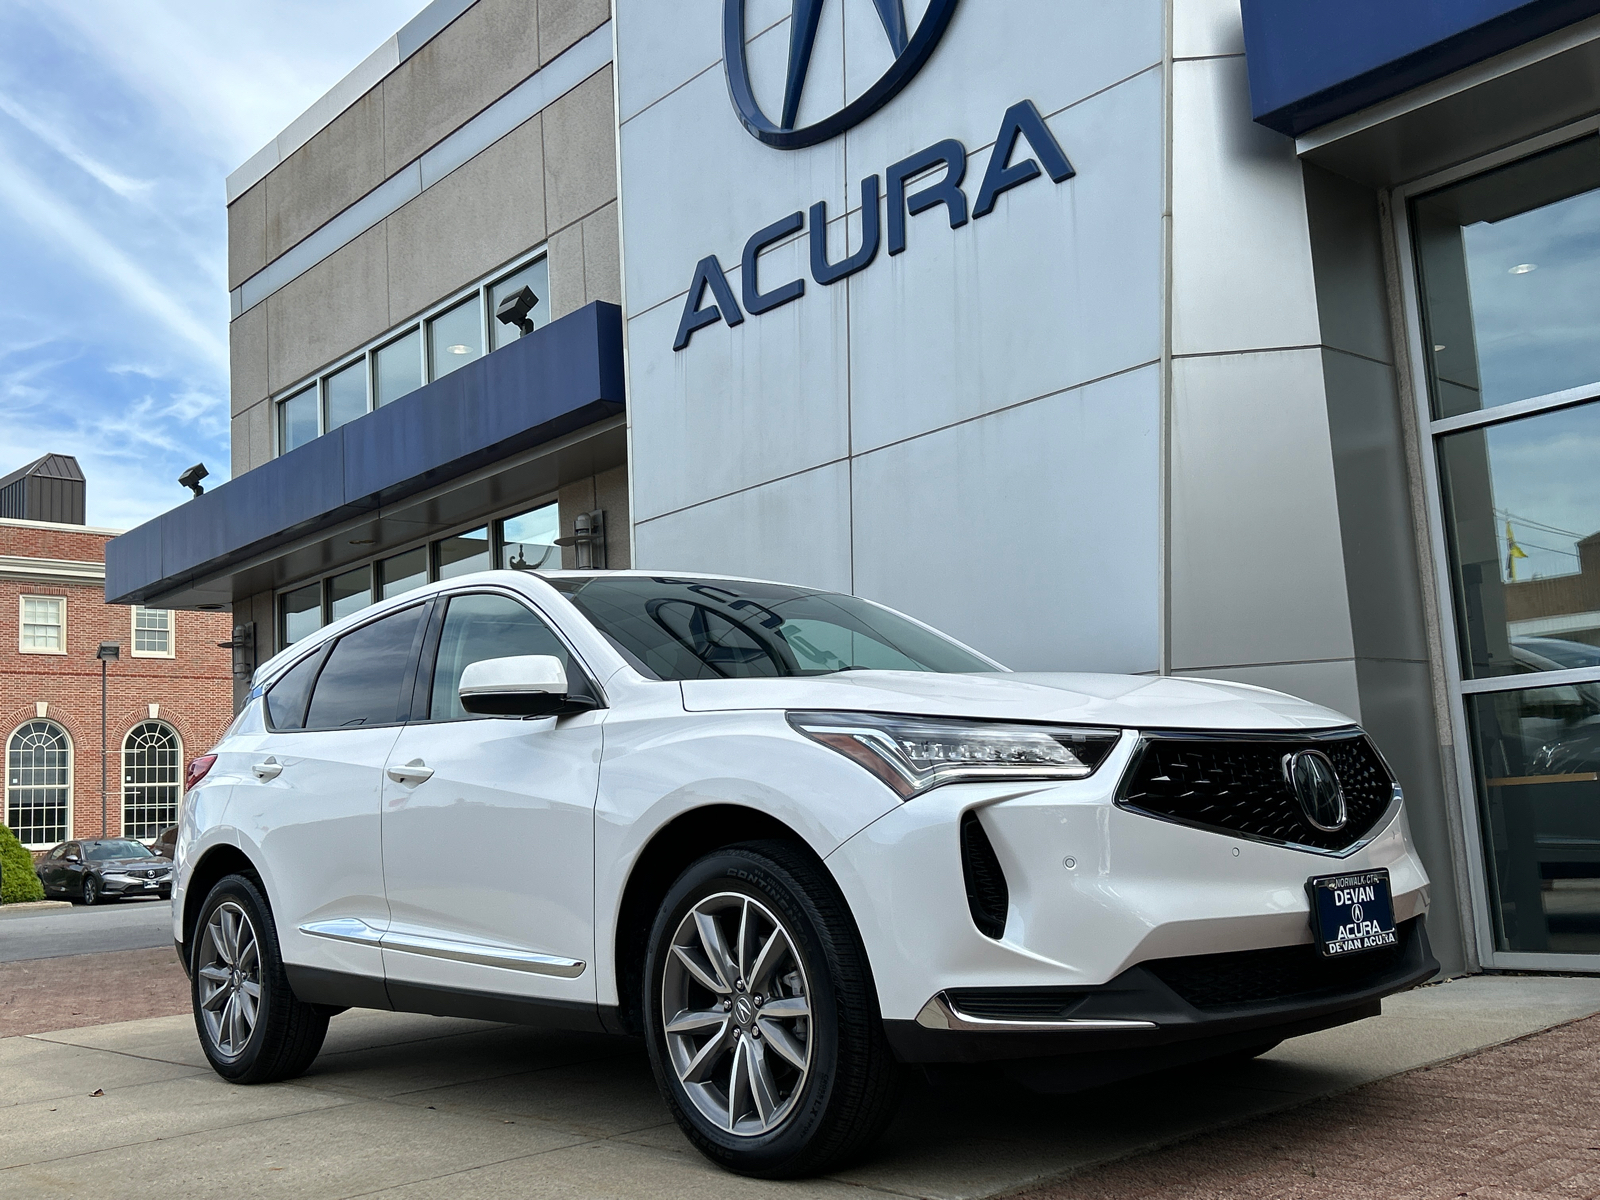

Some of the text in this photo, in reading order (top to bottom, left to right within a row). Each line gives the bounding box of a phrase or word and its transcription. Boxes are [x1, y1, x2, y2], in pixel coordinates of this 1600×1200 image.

[672, 98, 1076, 352] ACURA
[1366, 874, 1374, 884] CT
[1334, 886, 1375, 906] DEVAN
[1338, 920, 1381, 940] ACURA
[1329, 933, 1395, 953] DEVAN ACURA
